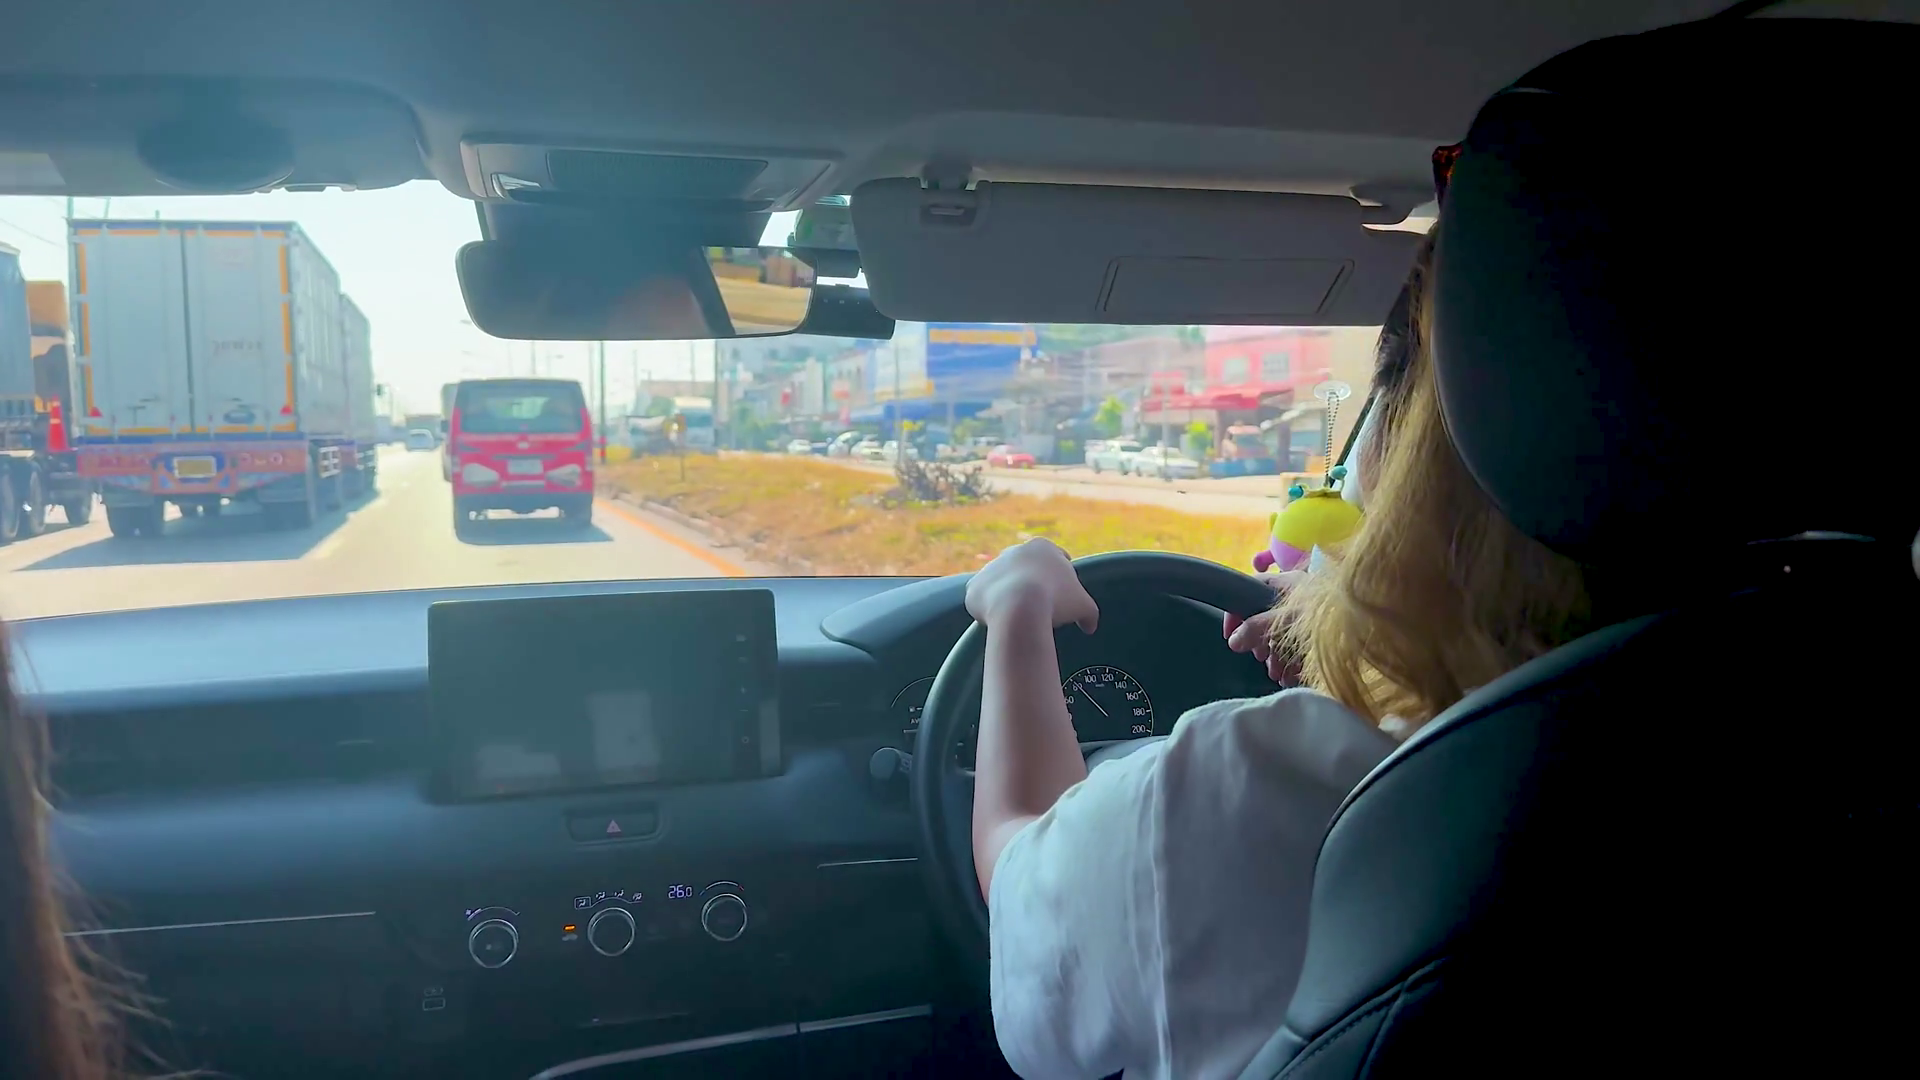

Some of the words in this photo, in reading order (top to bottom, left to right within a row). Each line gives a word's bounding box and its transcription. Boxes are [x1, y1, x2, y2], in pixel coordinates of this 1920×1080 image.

[1084, 675, 1097, 683] 100
[1115, 681, 1127, 689] 140
[1126, 692, 1139, 701] 160
[1133, 707, 1146, 716] 180
[1131, 725, 1146, 734] 200
